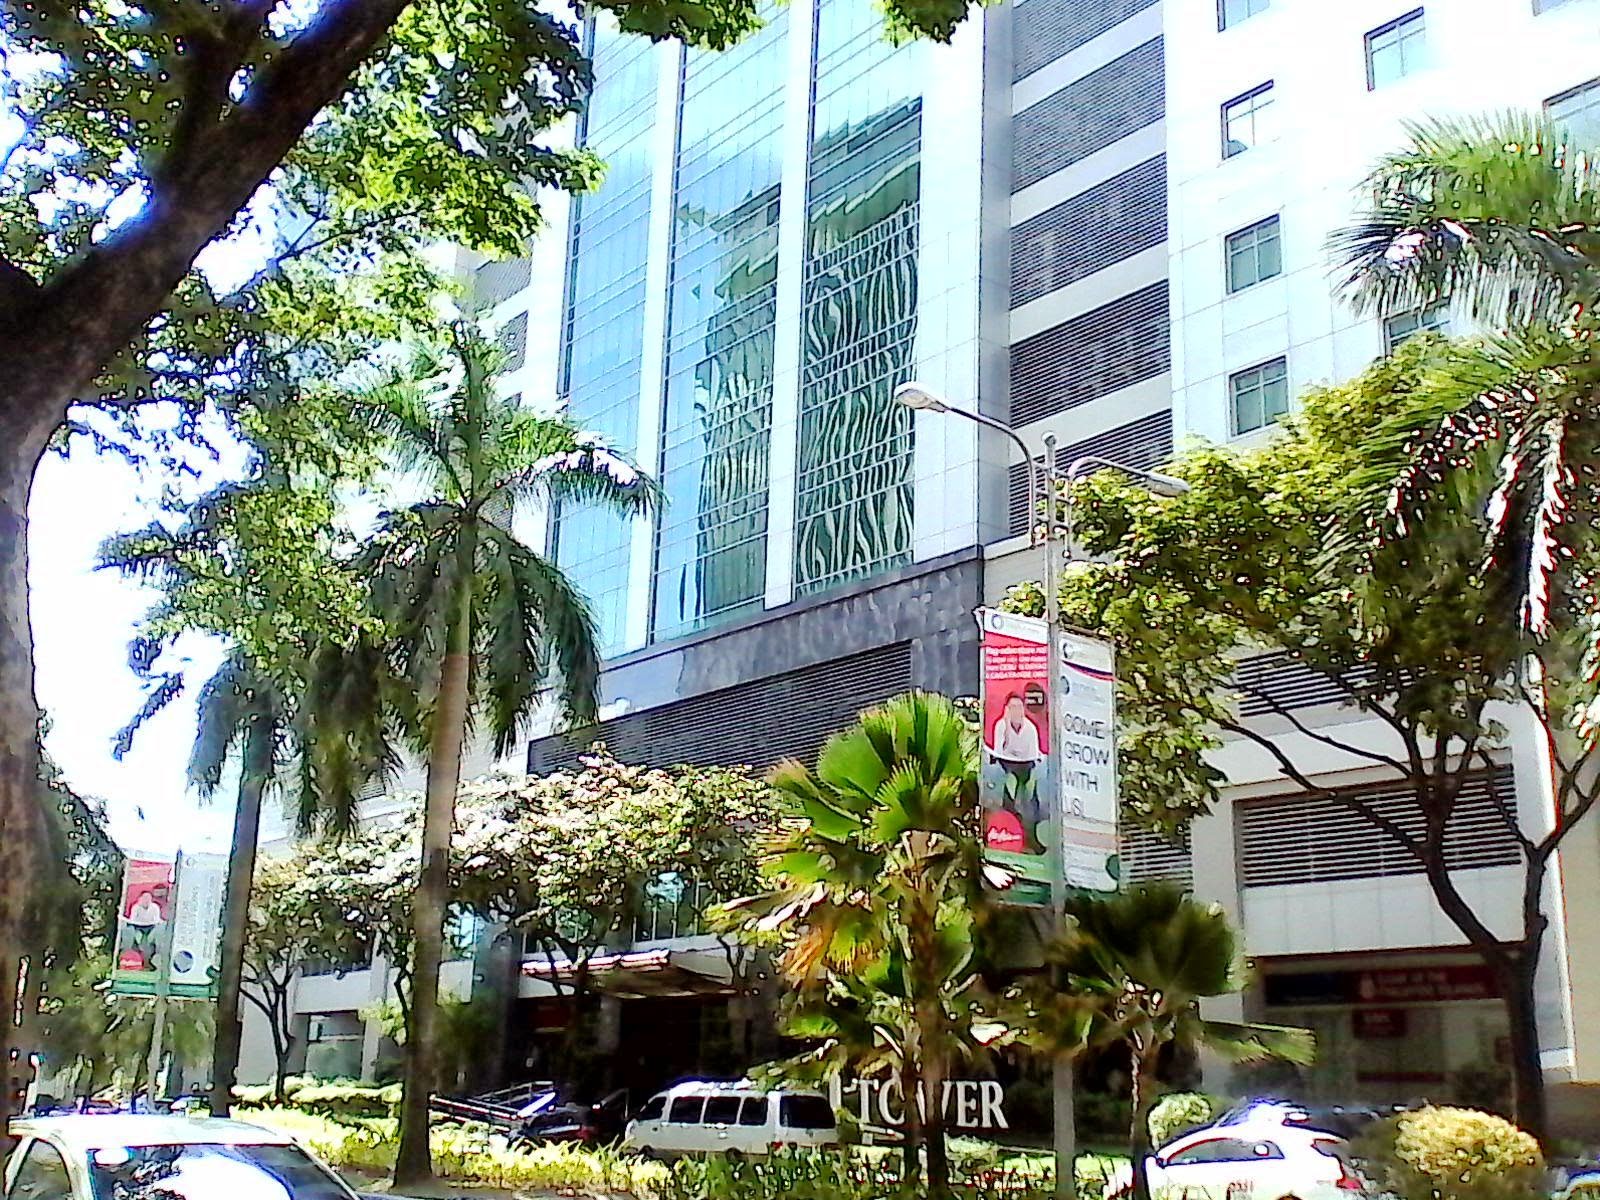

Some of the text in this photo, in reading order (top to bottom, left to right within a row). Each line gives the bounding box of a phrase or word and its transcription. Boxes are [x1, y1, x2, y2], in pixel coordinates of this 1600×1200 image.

[1064, 713, 1105, 740] COME
[1064, 740, 1110, 766] GROW
[1065, 769, 1099, 793] WITH
